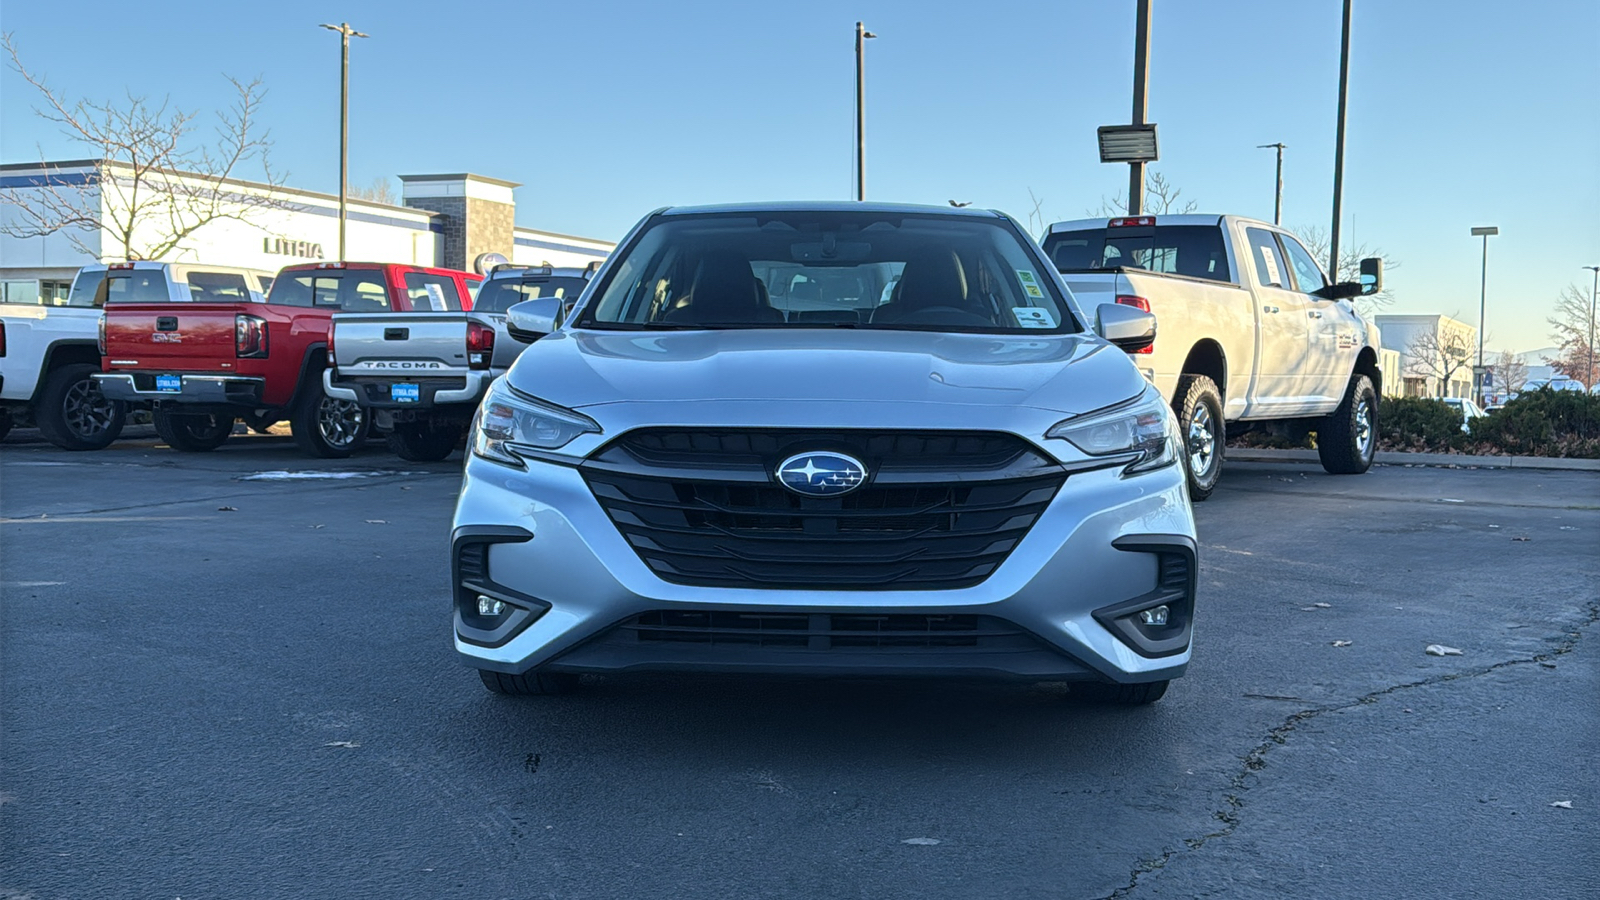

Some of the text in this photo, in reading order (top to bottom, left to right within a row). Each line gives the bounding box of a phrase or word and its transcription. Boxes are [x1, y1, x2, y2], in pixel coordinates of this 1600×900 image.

[264, 238, 325, 259] LITHIA
[152, 333, 181, 343] GMC
[392, 388, 419, 396] LITHIA.COM
